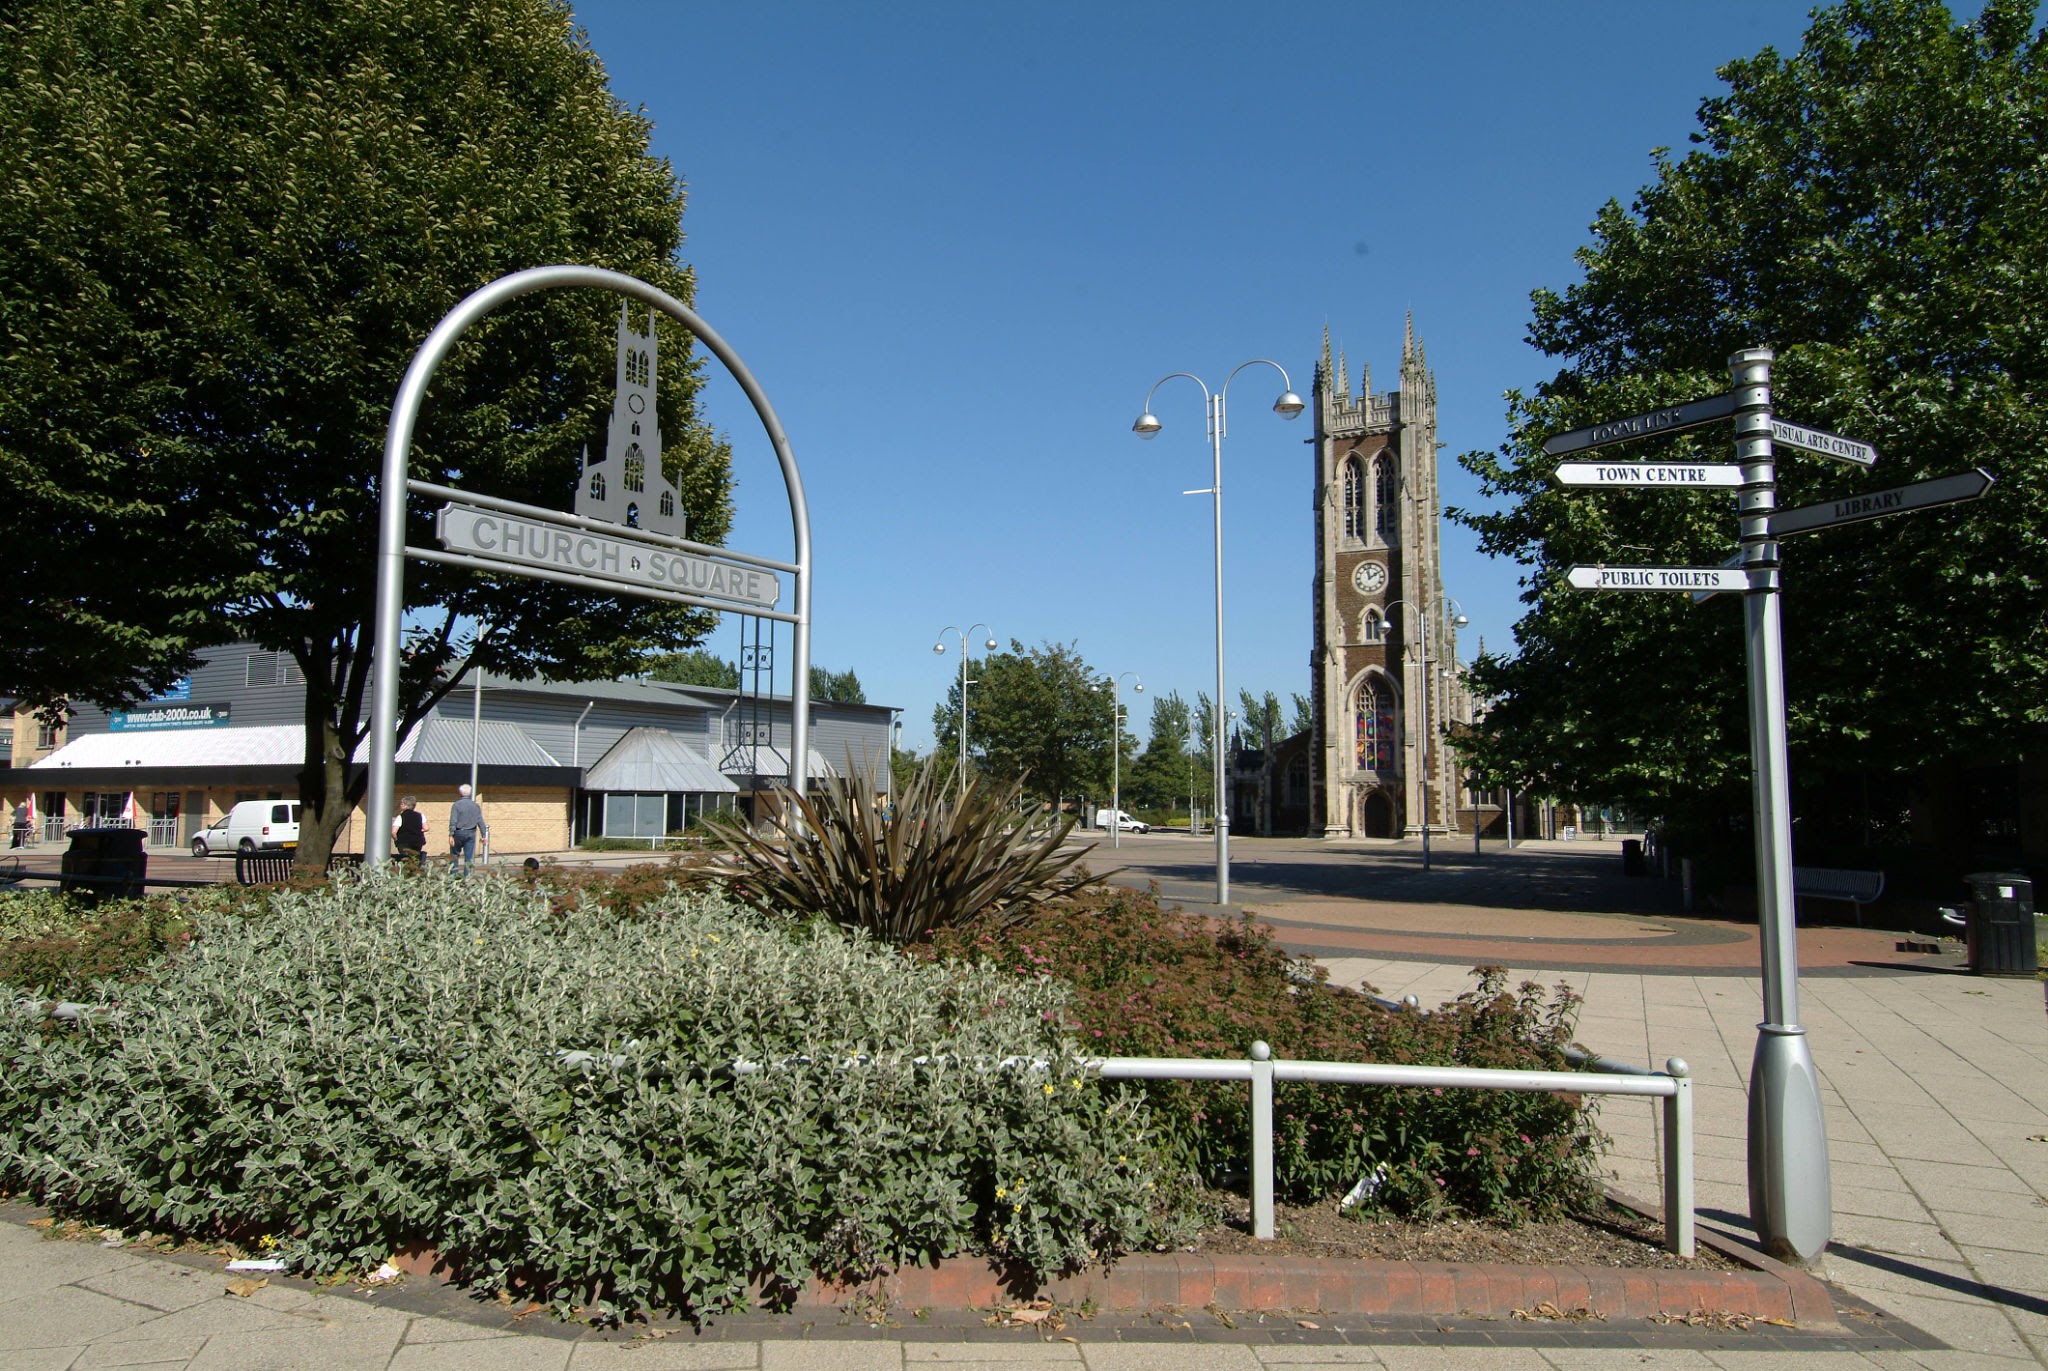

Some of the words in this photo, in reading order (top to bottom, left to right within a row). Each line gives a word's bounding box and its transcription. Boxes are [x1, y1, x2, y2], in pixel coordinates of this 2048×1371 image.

[1592, 421, 1640, 440] LOCAL
[1645, 409, 1681, 428] LINK
[1772, 422, 1805, 444] VISUAL
[1807, 433, 1830, 450] ARTS
[1832, 439, 1868, 460] CENTRE
[1597, 467, 1641, 481] TOWN
[1646, 468, 1706, 482] CENTRE
[1835, 491, 1903, 518] LIBRARY
[472, 516, 620, 574] CHURCH
[648, 552, 760, 599] SQUARE
[1601, 571, 1654, 586] PUBLIC
[1659, 572, 1720, 587] TOILETS
[126, 707, 212, 723] www.club-2000.co.uk
